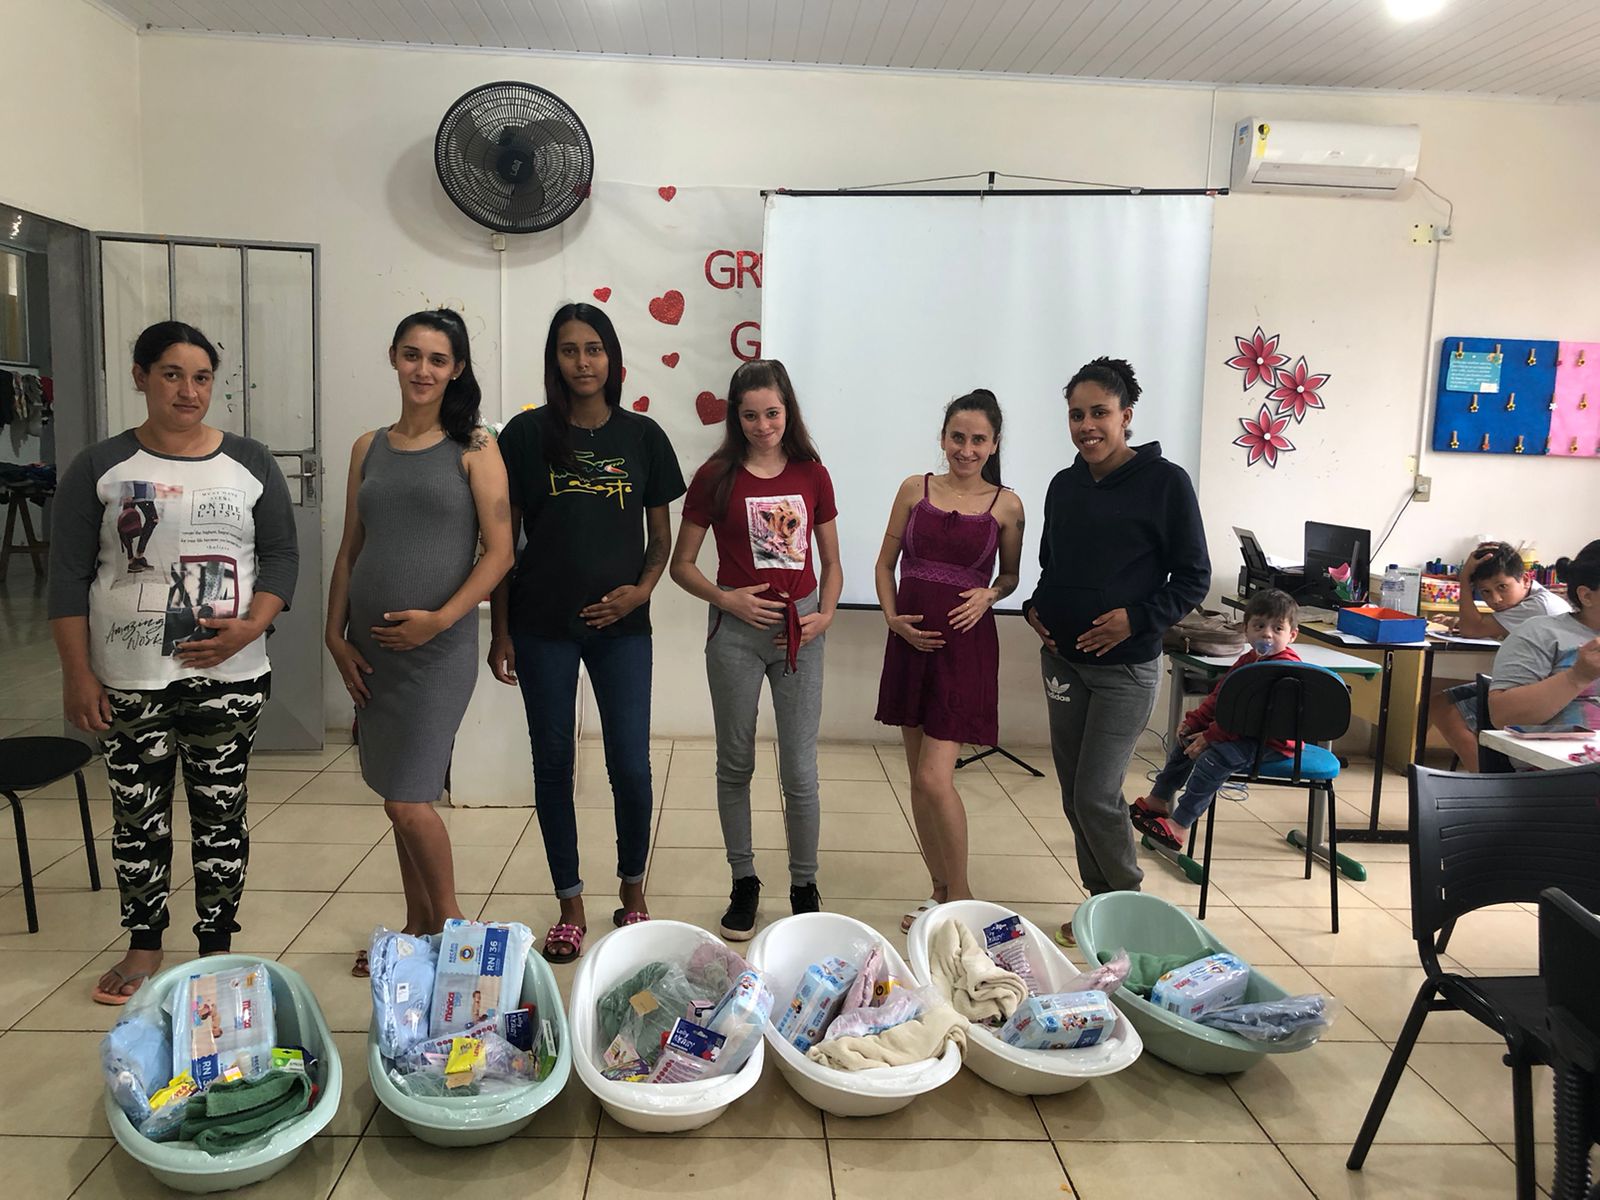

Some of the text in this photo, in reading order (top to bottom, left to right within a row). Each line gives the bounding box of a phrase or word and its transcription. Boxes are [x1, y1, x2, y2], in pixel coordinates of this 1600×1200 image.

[704, 249, 762, 289] GR
[106, 618, 164, 645] Amazing
[126, 631, 163, 651] Work
[486, 940, 498, 971] RN 36
[202, 1061, 212, 1076] RN
